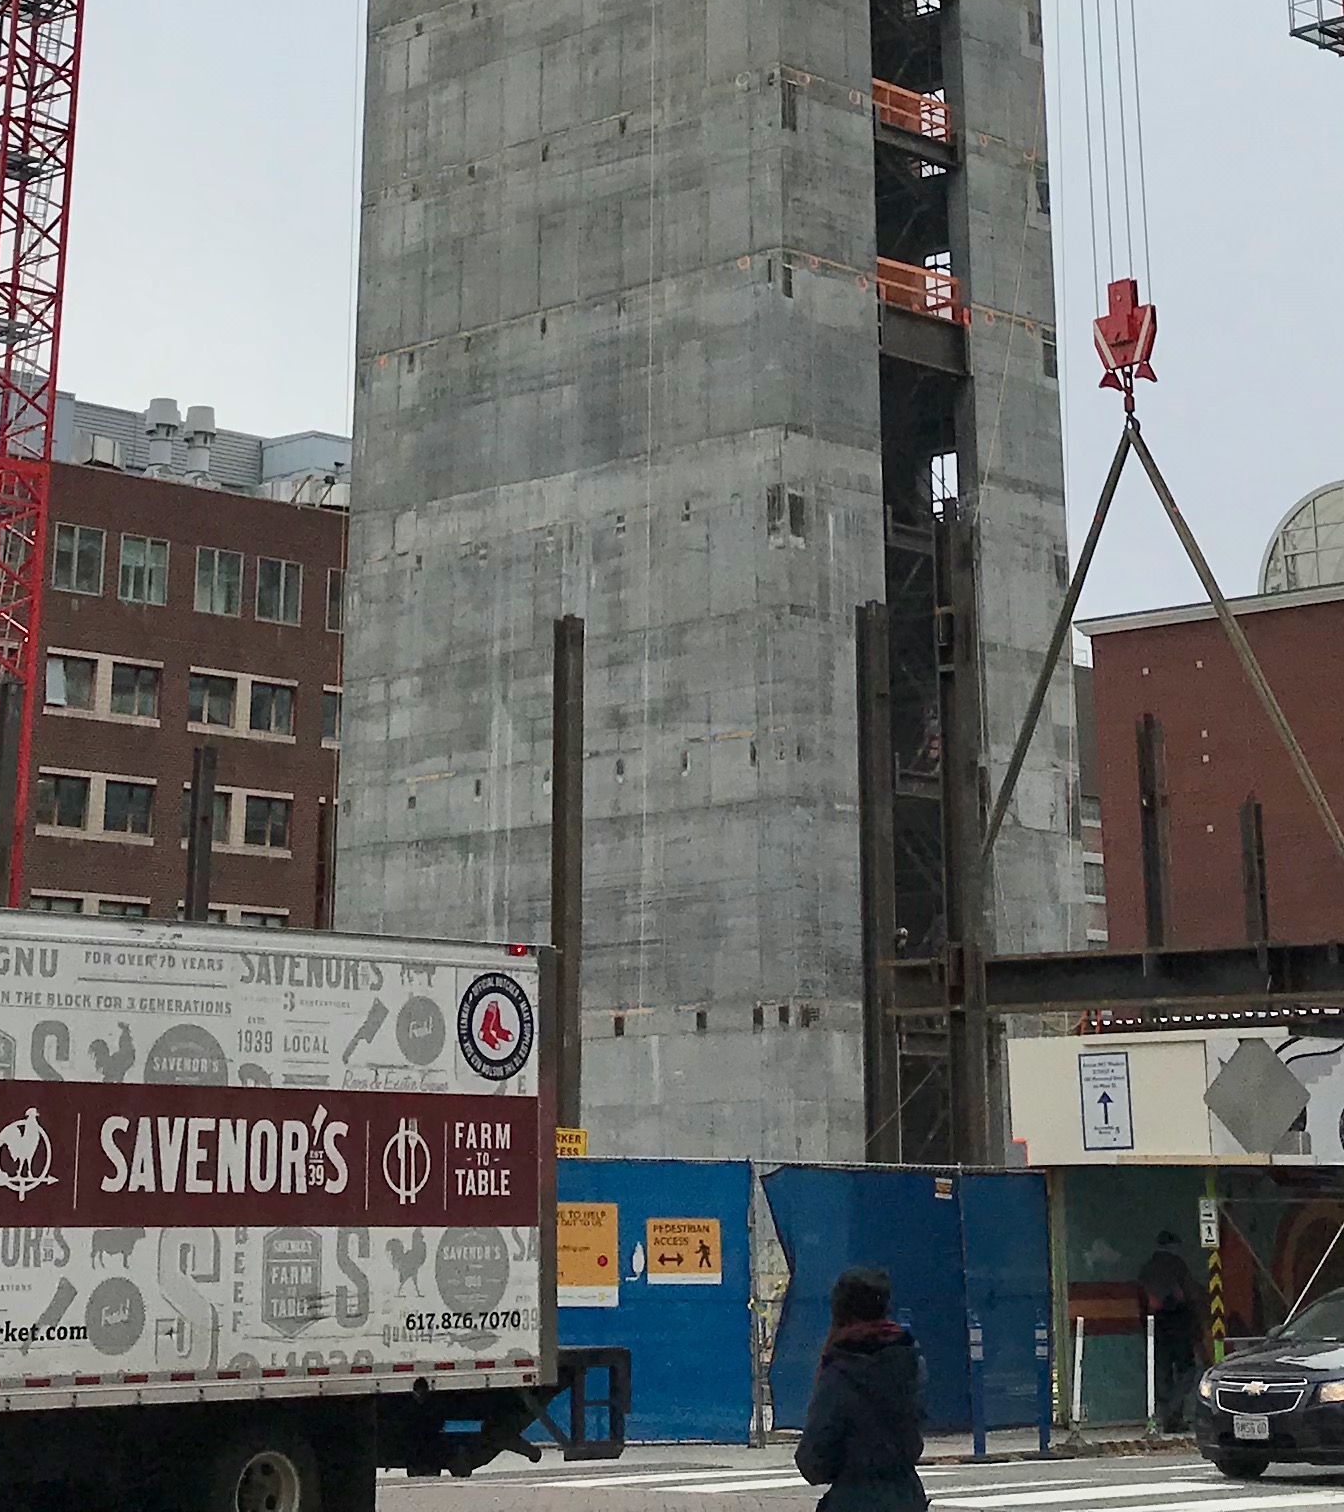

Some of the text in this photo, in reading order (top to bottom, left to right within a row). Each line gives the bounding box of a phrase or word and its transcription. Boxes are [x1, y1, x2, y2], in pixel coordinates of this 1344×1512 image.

[117, 953, 155, 967] OVER
[181, 957, 224, 971] YEARS
[239, 953, 384, 992] SAVENORS
[15, 991, 42, 1005] THE
[47, 993, 91, 1008] BLOCK
[97, 995, 122, 1009] FOR
[139, 998, 232, 1015] GENERATIONS
[237, 1028, 273, 1054] 1939
[283, 1035, 330, 1054] LOCAL
[454, 1121, 512, 1150] FARM
[100, 1104, 349, 1195] SAVENOR'S
[454, 1168, 512, 1197] TABLE
[653, 1224, 710, 1234] PEDESTRIAN
[653, 1237, 689, 1246] ACCESS
[405, 1311, 521, 1331] 617.876.7070
